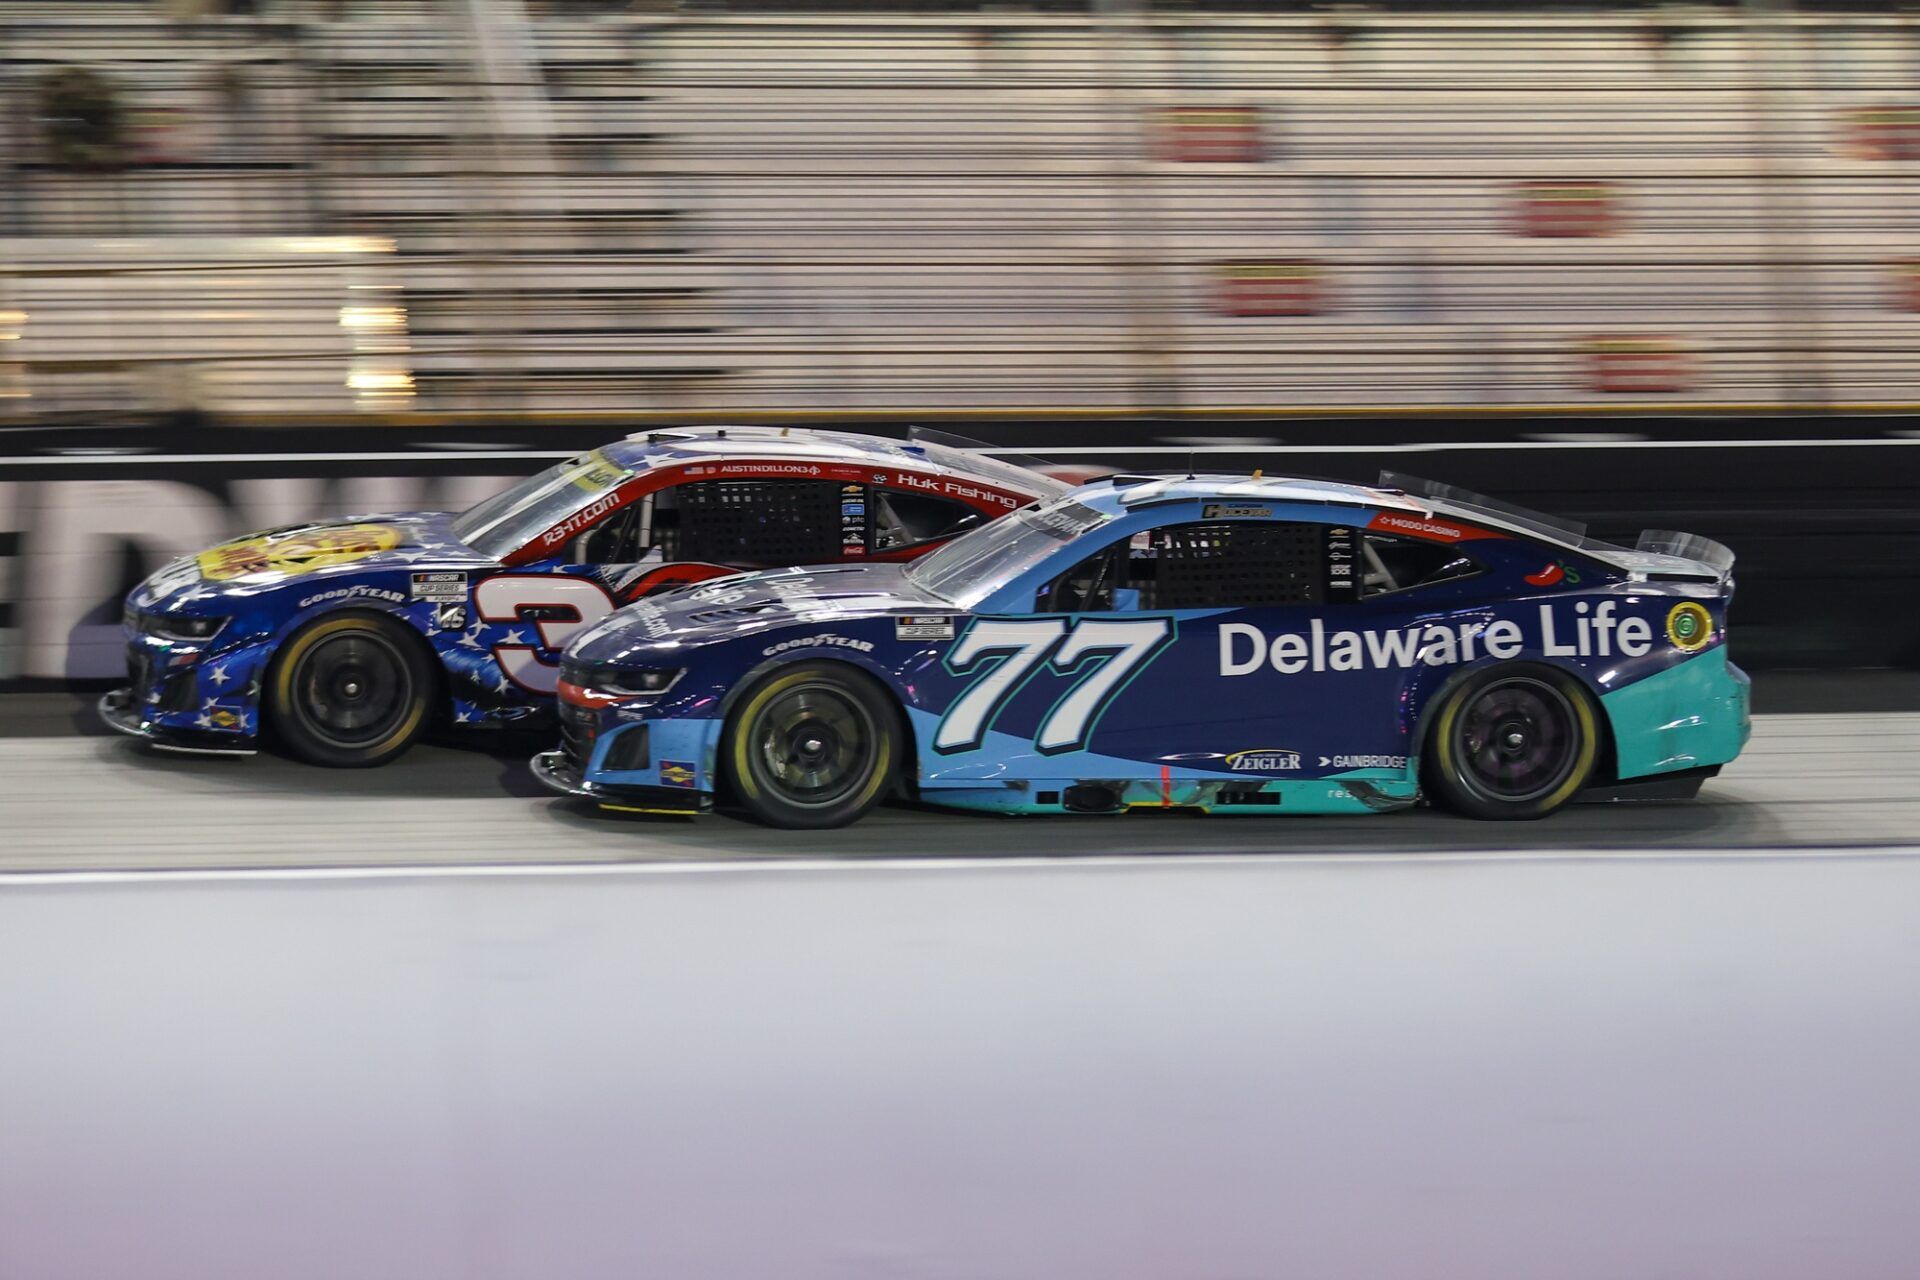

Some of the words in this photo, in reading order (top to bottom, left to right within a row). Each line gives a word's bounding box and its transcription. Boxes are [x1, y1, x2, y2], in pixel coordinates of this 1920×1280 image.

[721, 465, 809, 474] AUSTINDILLON3
[945, 481, 1017, 509] Fishing
[1391, 517, 1422, 531] MODO
[1423, 523, 1462, 538] CASINO
[300, 585, 405, 607] GOODYEAR
[762, 633, 875, 656] GOODYEAR
[1218, 618, 1523, 676] Delaware
[1538, 600, 1653, 657] Life
[934, 616, 1179, 756] 77
[1231, 754, 1301, 770] ZEIGLER
[1332, 755, 1407, 768] GAINBRIDGE
